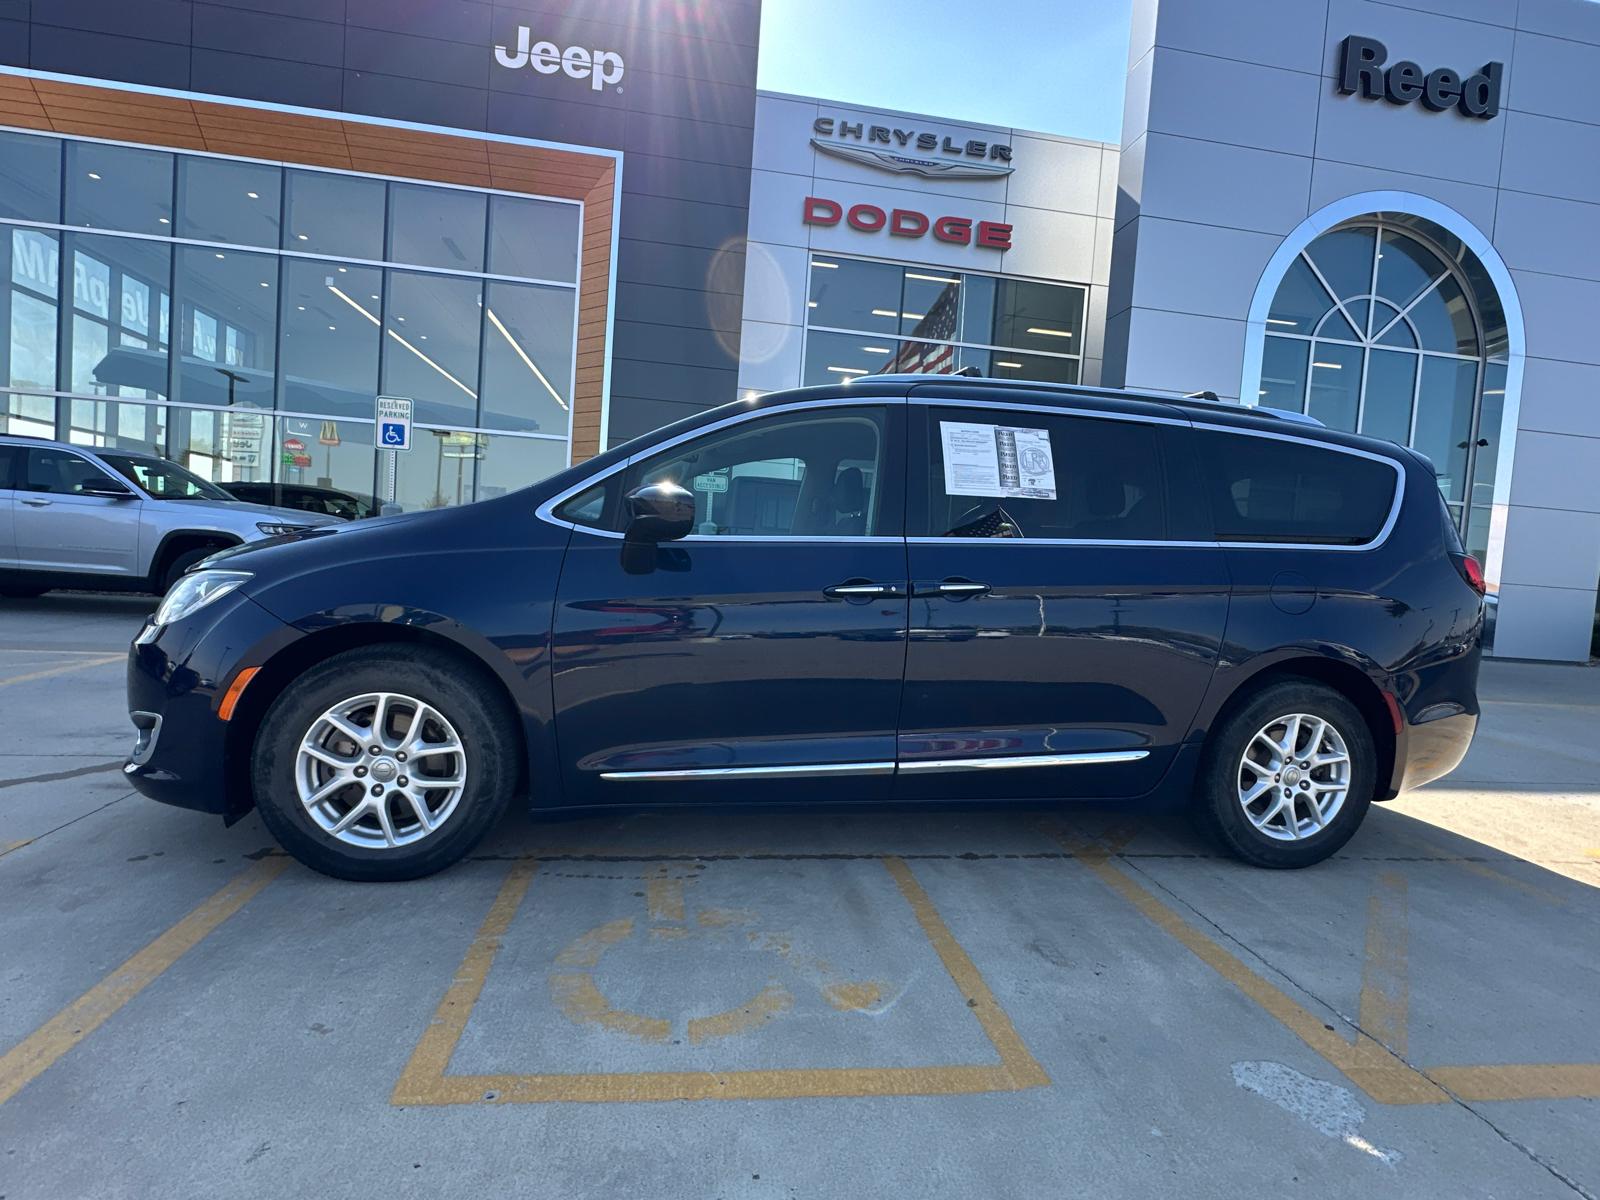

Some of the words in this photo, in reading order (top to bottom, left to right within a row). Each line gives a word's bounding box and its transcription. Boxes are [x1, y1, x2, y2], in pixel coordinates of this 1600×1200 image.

[494, 26, 624, 91] Jeep
[1339, 34, 1503, 119] Reed
[814, 117, 1013, 161] CHRYSLER
[893, 157, 934, 166] CHRYSLER
[803, 196, 1013, 250] DODGE
[379, 401, 410, 411] RESERVED
[379, 410, 410, 420] PARKING
